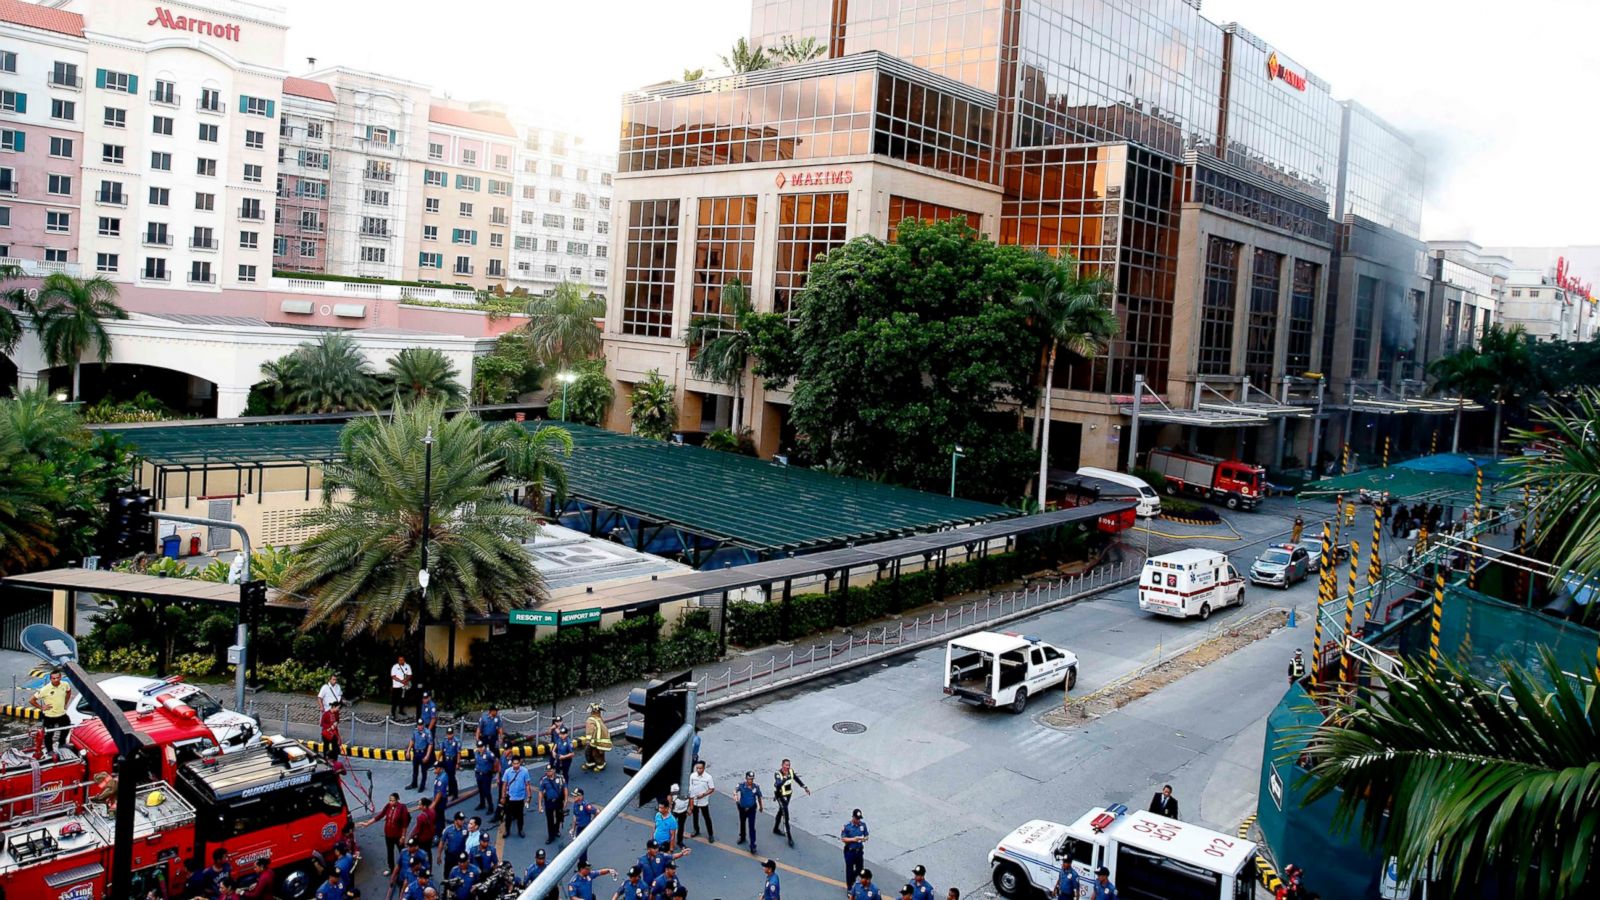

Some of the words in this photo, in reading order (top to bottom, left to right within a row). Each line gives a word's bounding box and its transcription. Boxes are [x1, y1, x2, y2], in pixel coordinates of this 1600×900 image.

[147, 7, 241, 42] Marriott
[1277, 64, 1306, 92] MAXIMS
[791, 170, 853, 187] MAXIMS
[516, 614, 543, 622] RESORT
[561, 613, 588, 622] NEWPORT
[1204, 838, 1234, 857] 012
